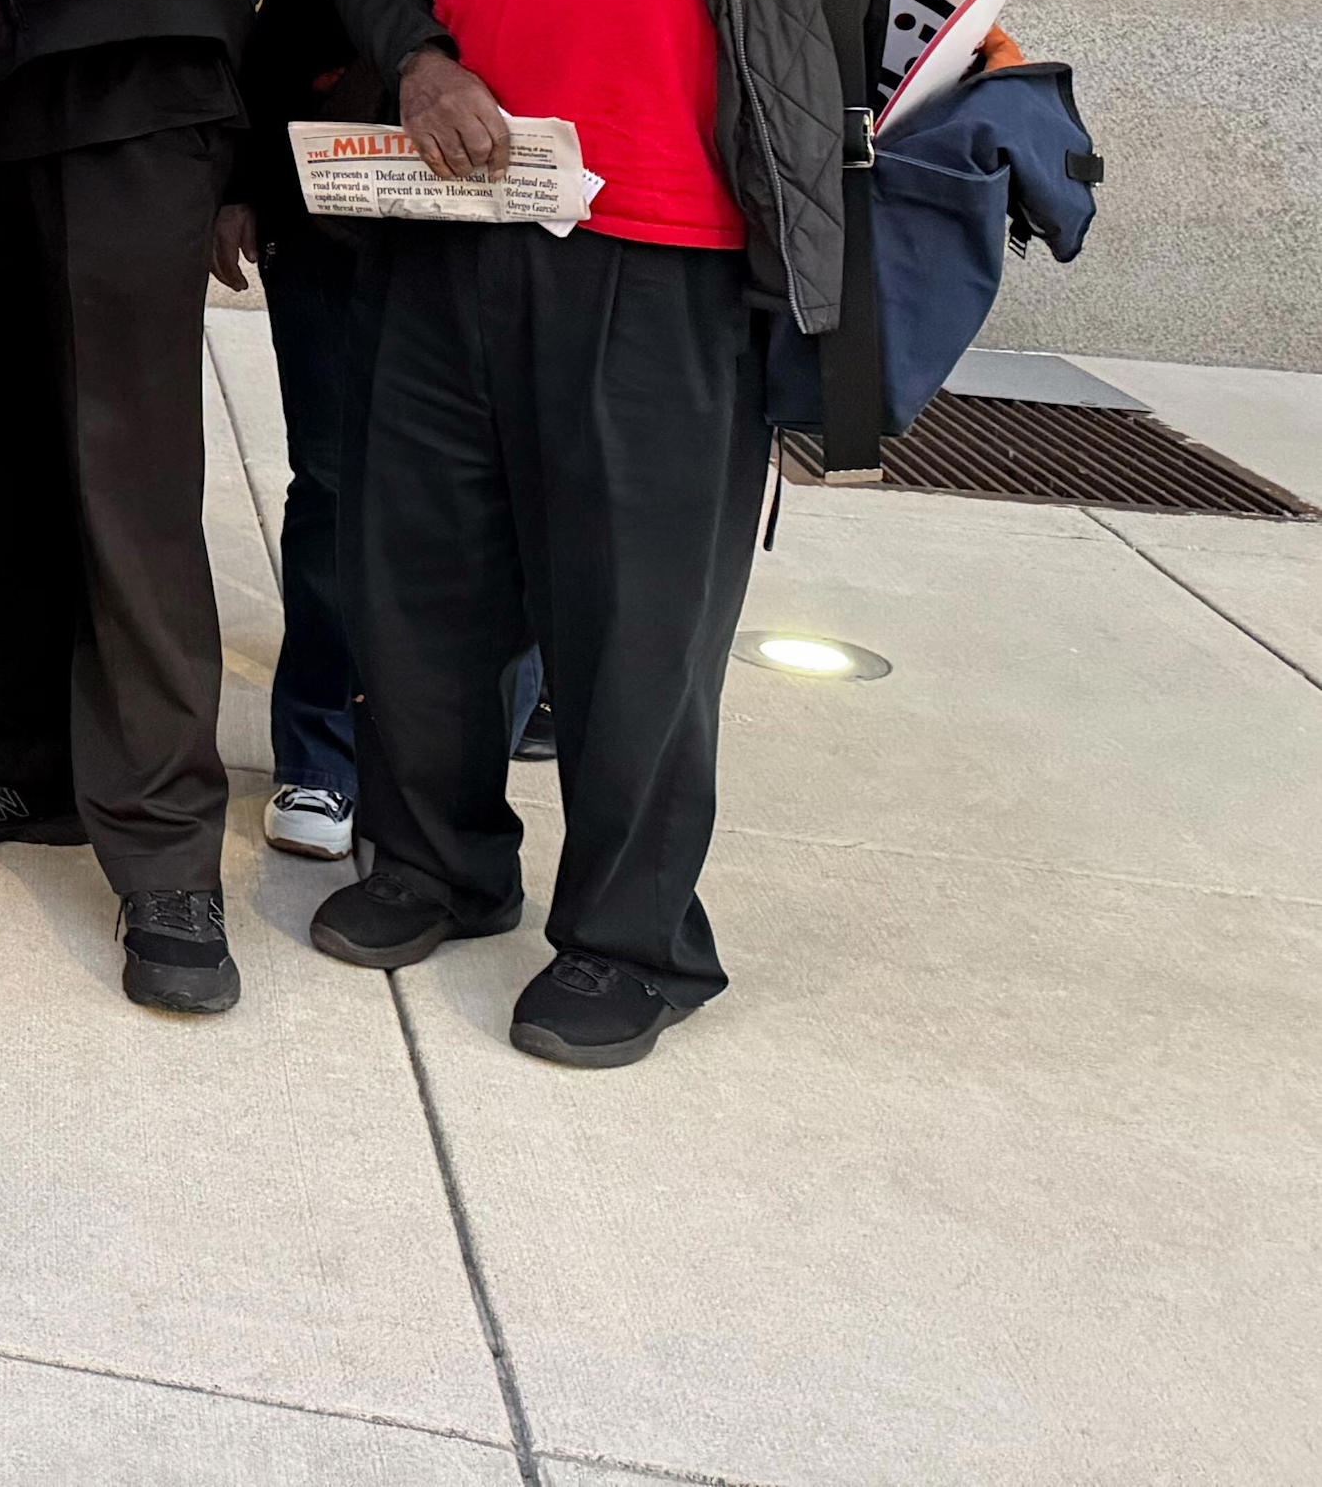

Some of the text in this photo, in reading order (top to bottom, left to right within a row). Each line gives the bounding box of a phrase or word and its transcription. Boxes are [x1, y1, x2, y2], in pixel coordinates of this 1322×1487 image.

[307, 148, 328, 159] THE
[310, 170, 331, 179] SWP
[332, 170, 362, 180] presents
[375, 170, 405, 181] Defeat
[407, 170, 417, 181] of
[313, 181, 329, 190] road
[331, 181, 360, 190] forward
[376, 186, 412, 197] prevent
[424, 188, 443, 196] new
[446, 185, 494, 198] Holocaust
[314, 193, 347, 202] capitalist
